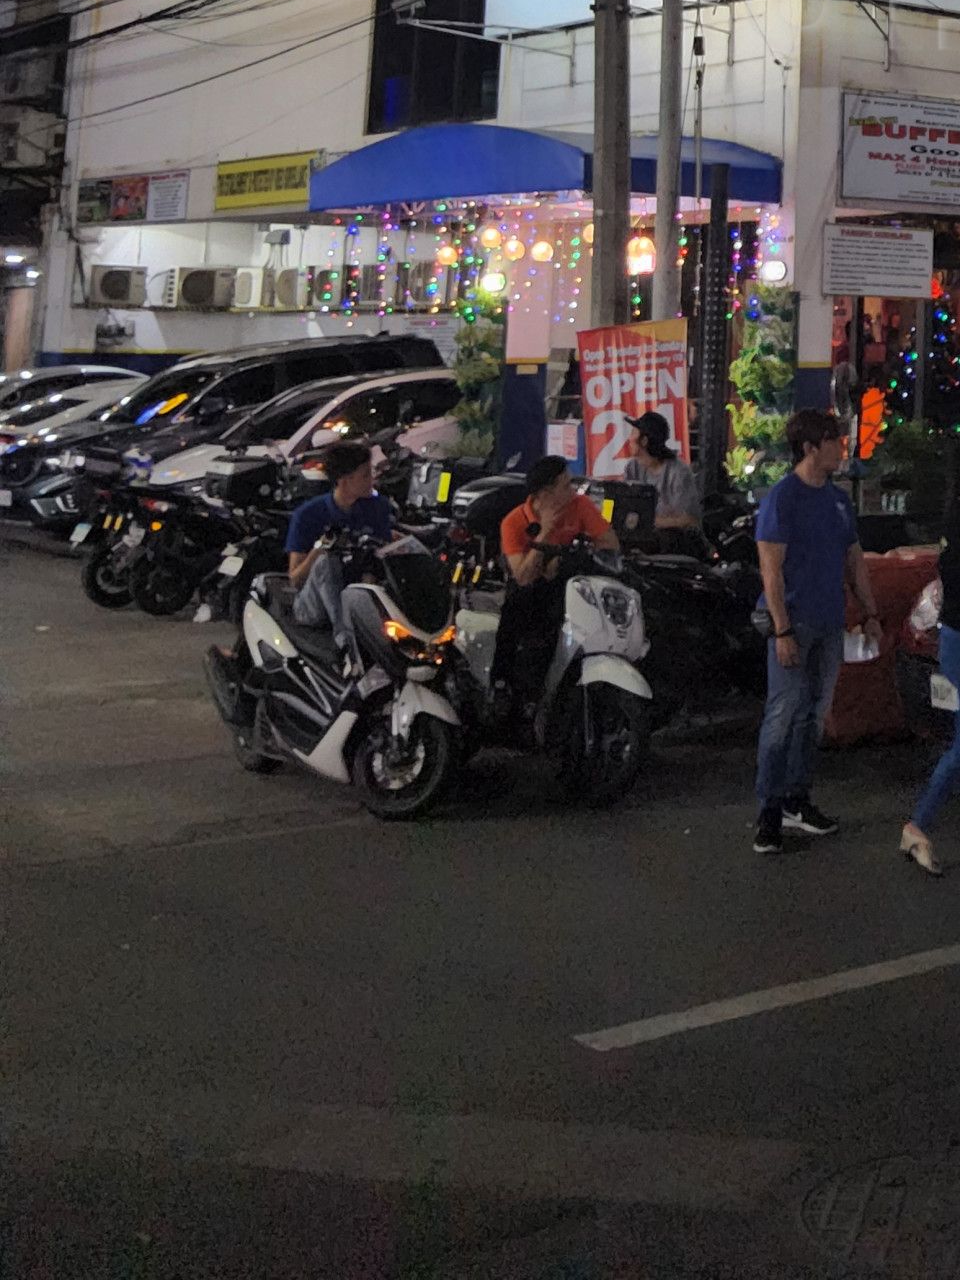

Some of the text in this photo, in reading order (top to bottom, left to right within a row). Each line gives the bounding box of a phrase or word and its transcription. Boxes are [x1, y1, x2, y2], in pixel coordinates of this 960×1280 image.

[867, 151, 906, 164] MAX
[911, 155, 922, 165] 4
[585, 366, 685, 408] OPEN
